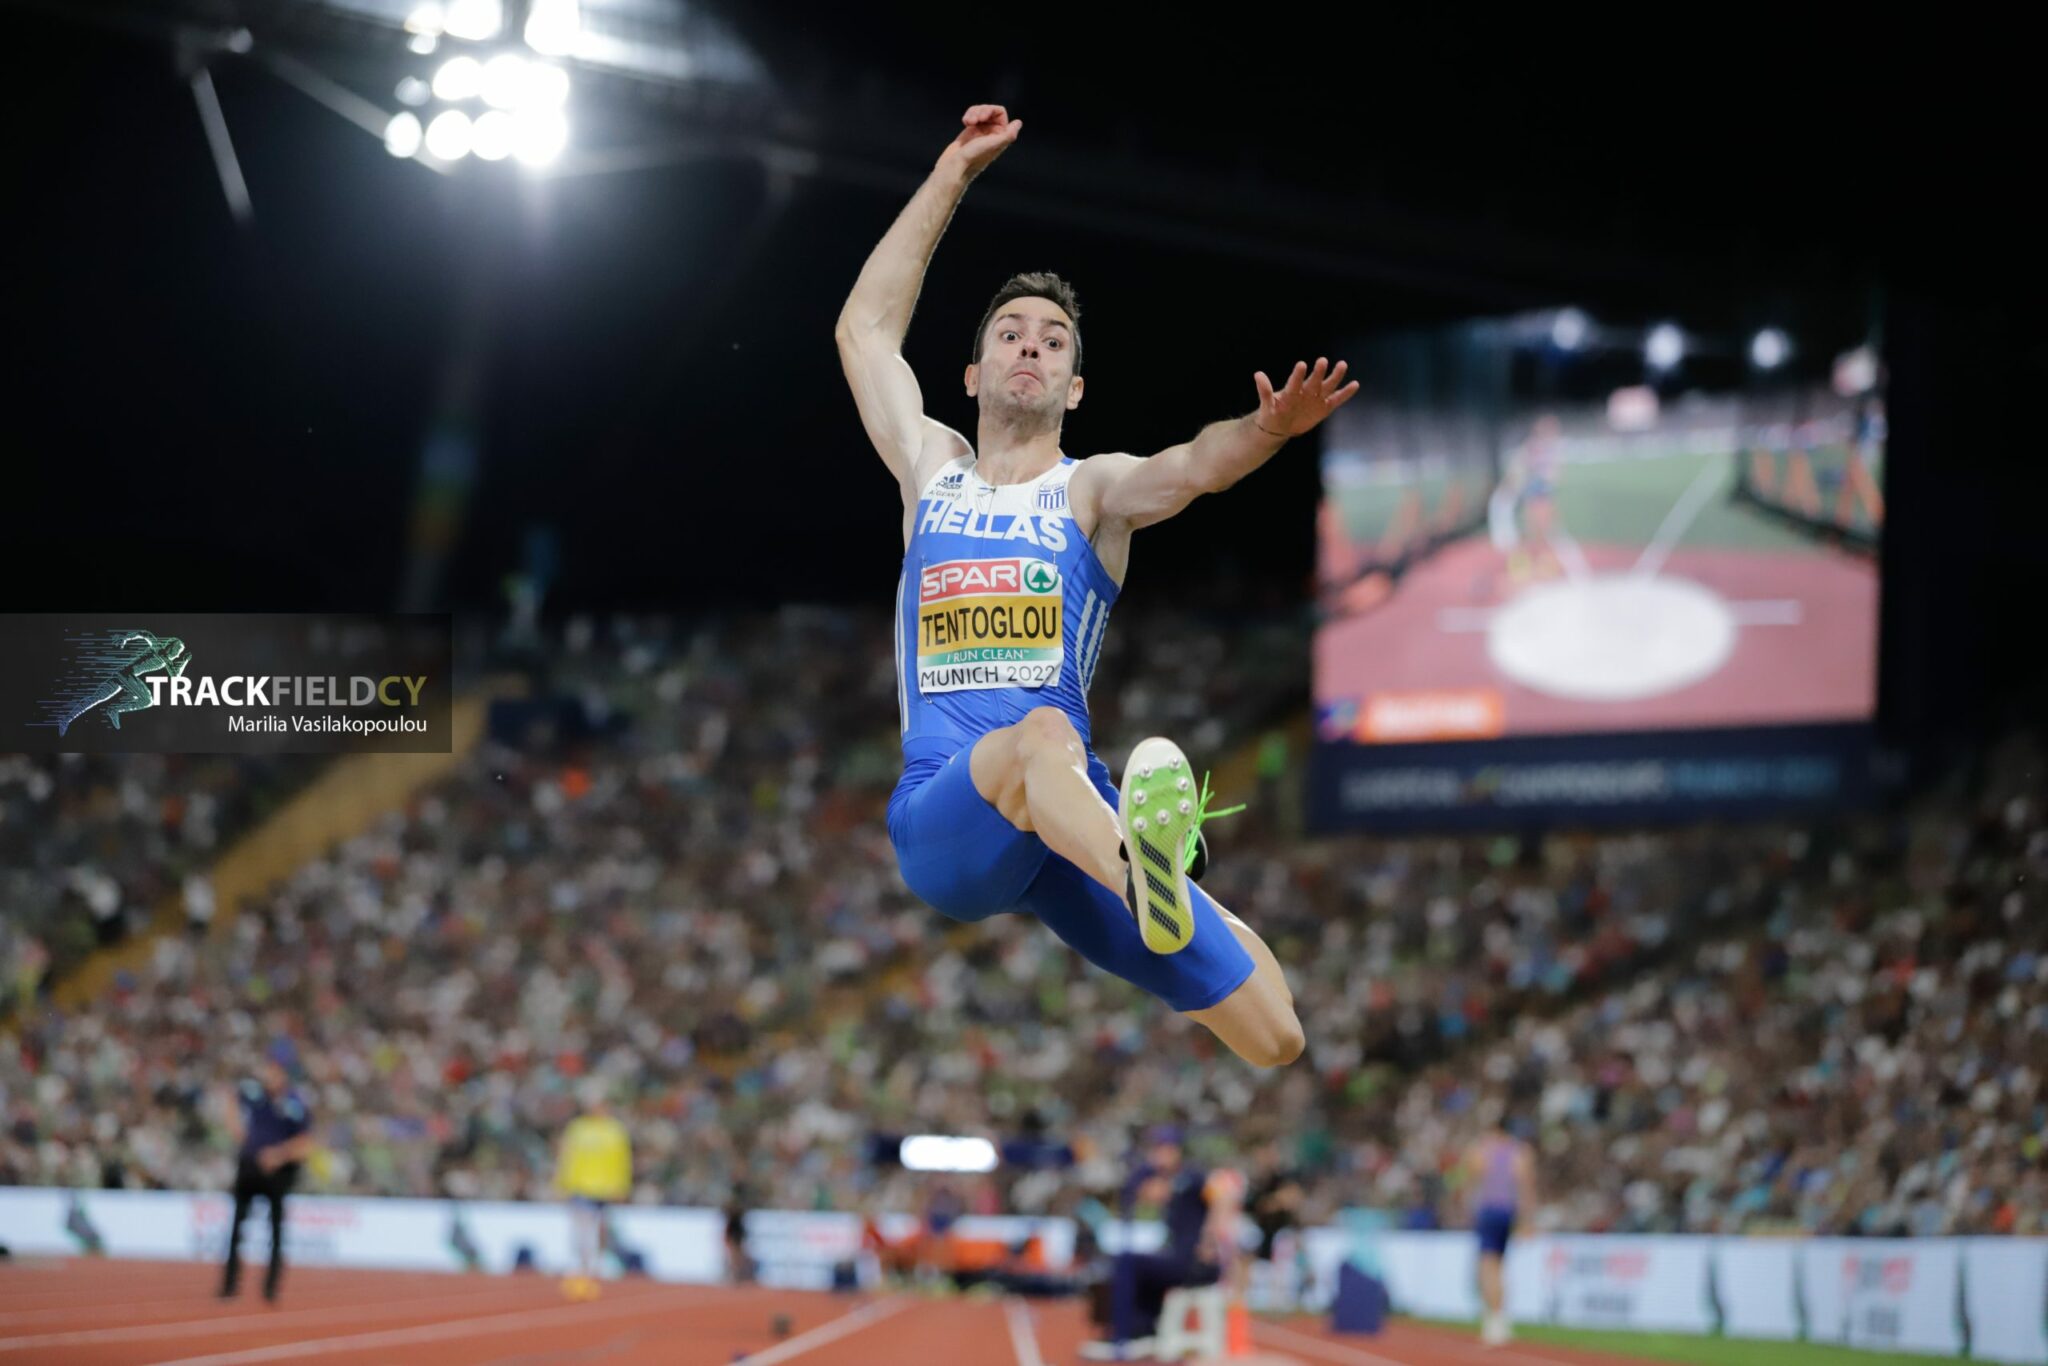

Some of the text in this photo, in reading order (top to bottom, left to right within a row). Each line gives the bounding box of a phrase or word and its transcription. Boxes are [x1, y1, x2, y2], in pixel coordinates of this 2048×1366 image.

[919, 500, 1068, 552] HELLAS
[922, 565, 1018, 597] SPAR
[922, 606, 1057, 647] TENTOGLOU
[953, 649, 978, 662] RUN
[920, 666, 999, 688] MUNICH
